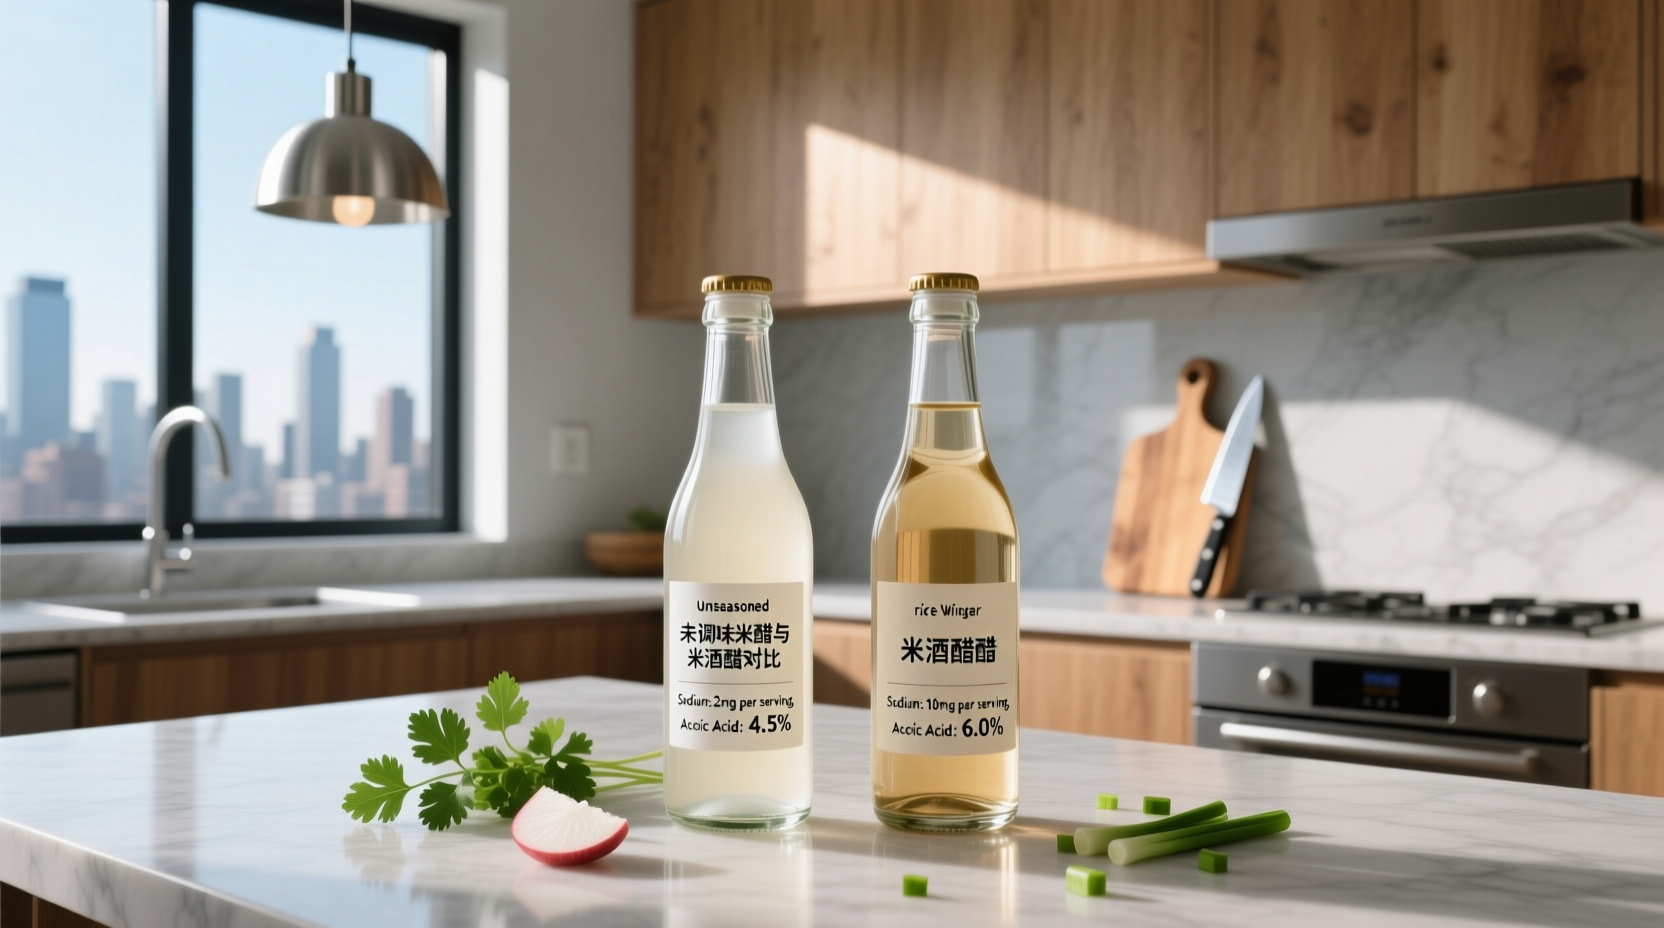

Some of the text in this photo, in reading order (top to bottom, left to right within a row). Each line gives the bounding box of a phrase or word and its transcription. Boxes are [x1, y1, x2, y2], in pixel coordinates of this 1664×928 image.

[739, 698, 756, 711] per
[711, 719, 744, 733] Acid:
[748, 714, 792, 733] 4.5%
[925, 723, 957, 737] Acid:
[962, 716, 1004, 737] 6.0%
